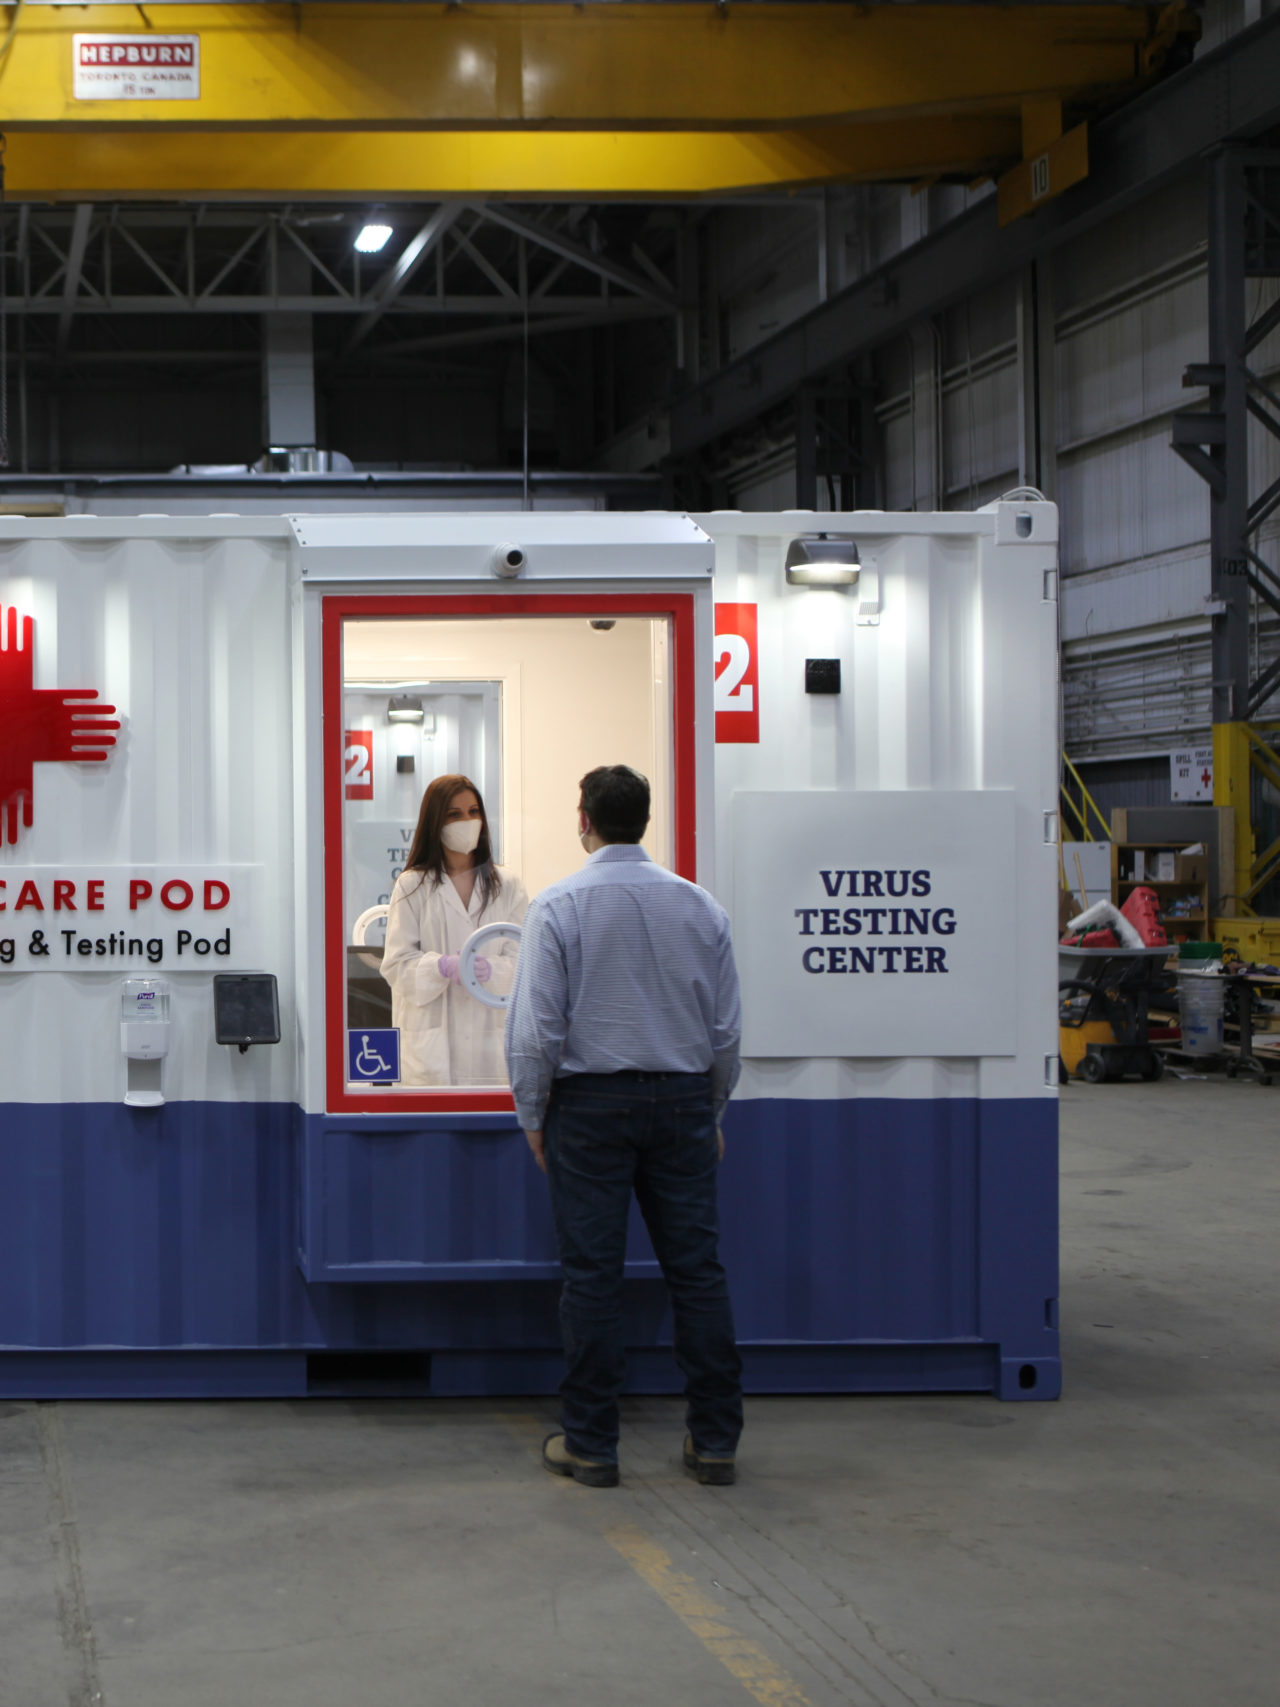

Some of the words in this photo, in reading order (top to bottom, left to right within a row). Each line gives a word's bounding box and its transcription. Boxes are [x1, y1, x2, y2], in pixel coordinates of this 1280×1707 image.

[81, 45, 191, 63] HEPBURN
[80, 72, 136, 82] TORONTO
[142, 72, 192, 82] CANADA
[715, 634, 754, 712] 2
[129, 880, 231, 911] POD
[819, 870, 932, 897] VIRUS
[795, 908, 958, 936] TESTING
[28, 930, 50, 957] &
[61, 930, 164, 963] Testing
[177, 928, 231, 956] Pod
[802, 947, 949, 974] CENTER
